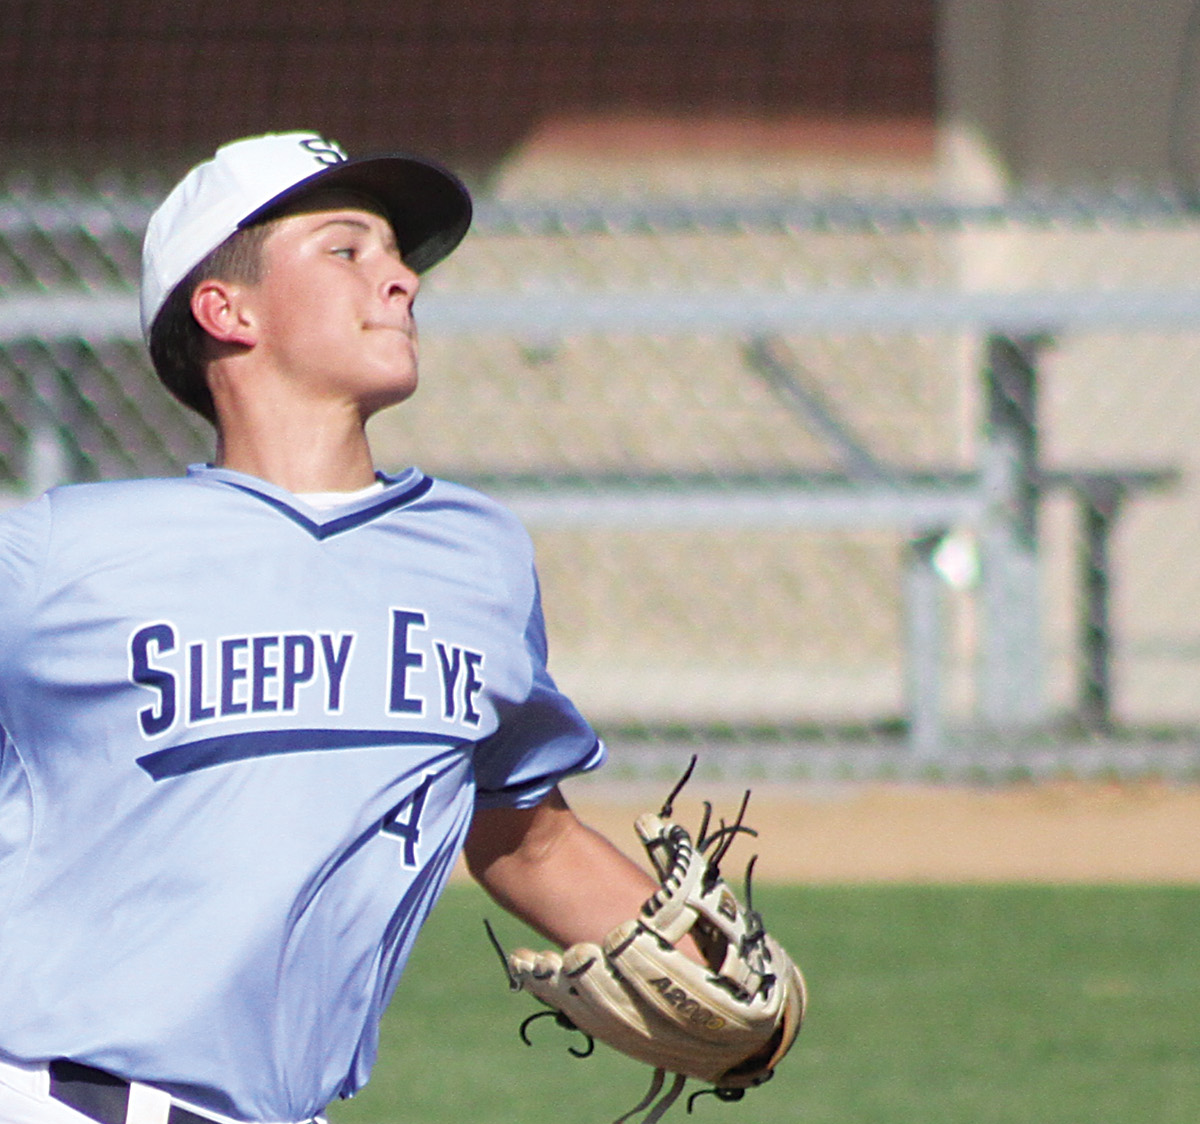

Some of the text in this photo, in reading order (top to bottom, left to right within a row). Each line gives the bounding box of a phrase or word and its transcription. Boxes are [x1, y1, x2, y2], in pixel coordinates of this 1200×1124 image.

[131, 608, 483, 737] SLEEPY EYE
[380, 770, 436, 867] 4
